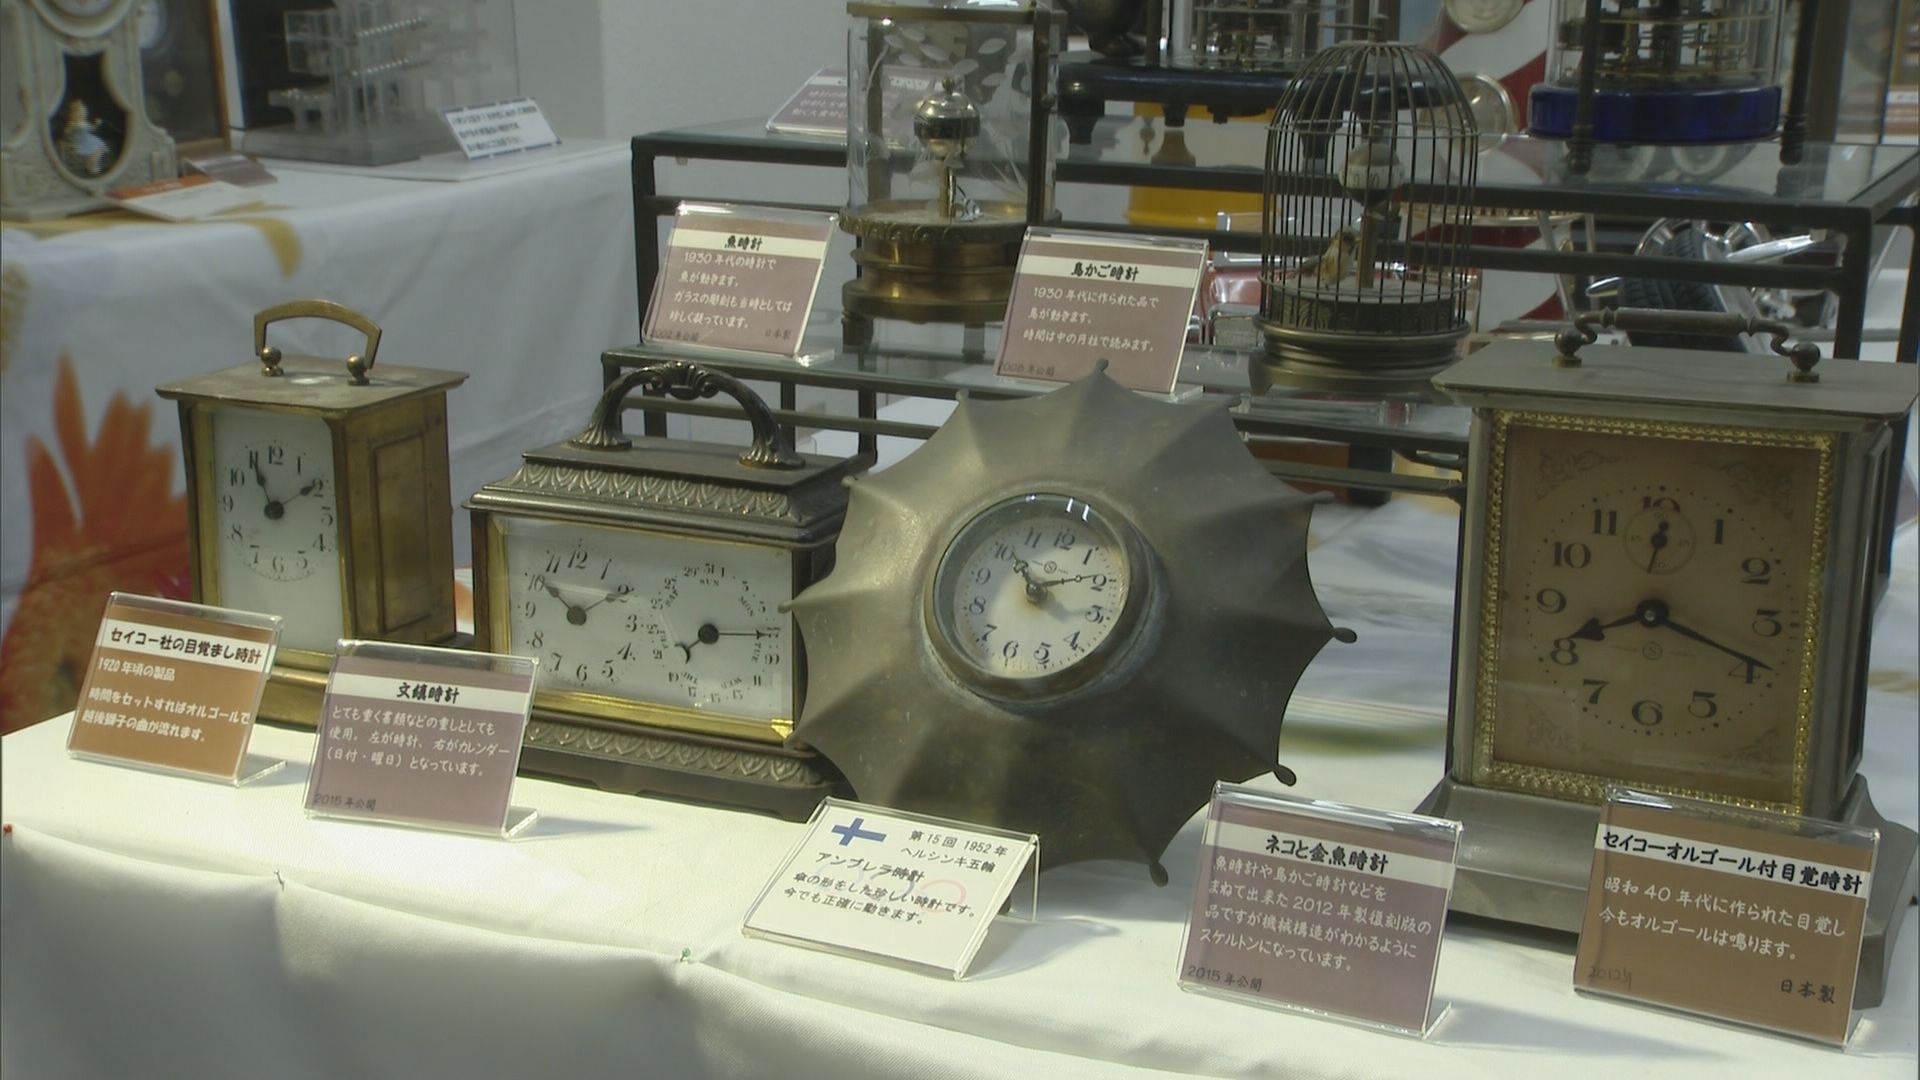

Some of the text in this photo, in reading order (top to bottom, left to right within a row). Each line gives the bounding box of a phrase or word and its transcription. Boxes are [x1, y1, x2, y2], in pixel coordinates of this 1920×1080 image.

[724, 235, 763, 250] 魚時計
[1070, 261, 1140, 282] 鳥かご時計
[1028, 306, 1092, 324] 鳥が動きます。
[1592, 508, 1618, 536] 11
[1713, 518, 1724, 545] 1
[1553, 541, 1592, 570] 10
[1740, 557, 1772, 586] 2
[1536, 588, 1568, 614] 9
[1752, 608, 1782, 638] 3
[111, 627, 262, 665] セイコー社の目覚まし時計
[1550, 637, 1580, 666] 8
[1728, 655, 1761, 685] 4
[88, 687, 251, 726] 時間をセットすればオルゴールで
[397, 681, 460, 705] 文鎮時計
[1582, 678, 1610, 705] 7
[1687, 690, 1718, 720] 5
[82, 710, 205, 743] 越後獅子の曲が流れます。
[332, 706, 496, 736] とても重く書類などの重しとしても
[1632, 700, 1664, 726] 6
[815, 851, 926, 884] アンブレラ時計
[900, 845, 996, 873] ヘルシンキ五輪
[1265, 834, 1389, 875] ネコと金魚時計
[1602, 831, 1862, 895] セイコーオルゴール付目覚時計
[1212, 855, 1387, 902] 魚時計や鳥かご時計などを
[784, 887, 924, 925] 今でも正確に動きます。
[793, 871, 976, 918] 傘の形をした珍しい時計です。
[1204, 904, 1417, 958] 品ですが機械構造がわかるように
[1598, 906, 1797, 960] 今もオルゴールは鳴ります。
[1200, 928, 1352, 972] スケルトンになっています。
[1780, 978, 1836, 1005] 日本製
